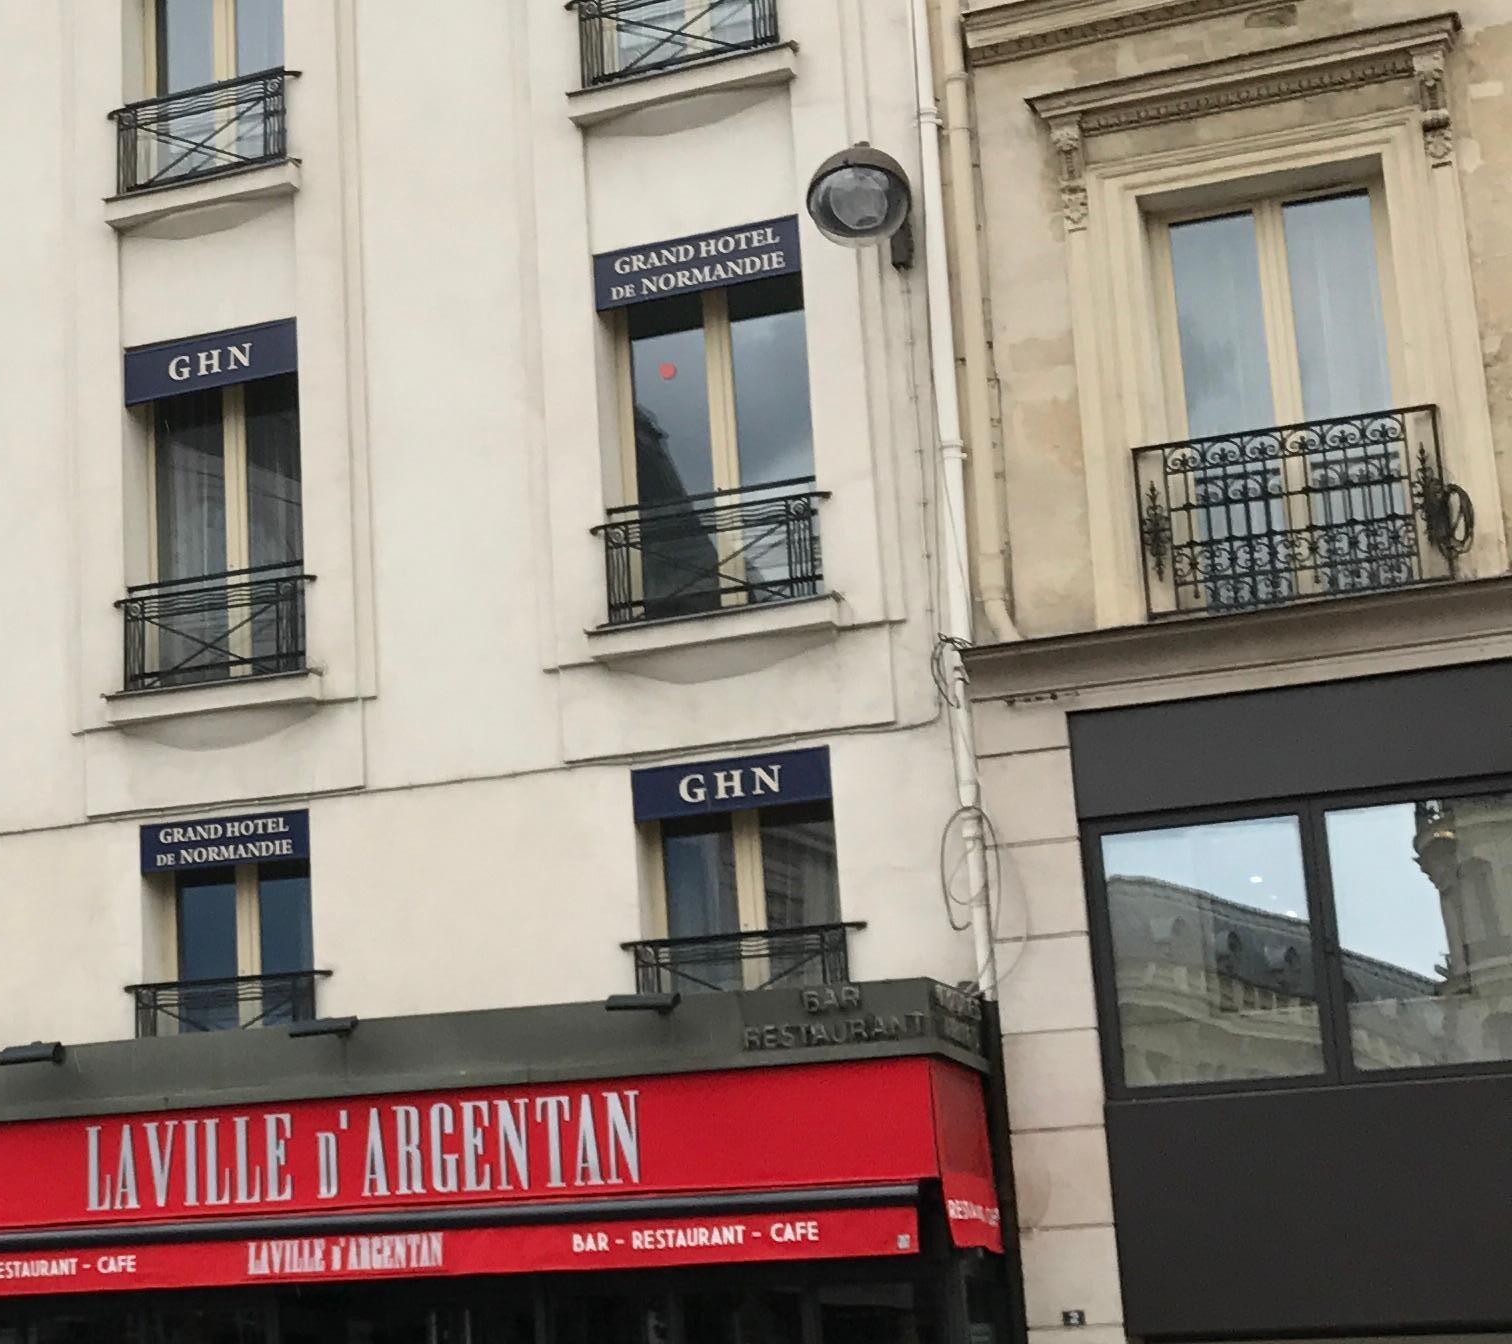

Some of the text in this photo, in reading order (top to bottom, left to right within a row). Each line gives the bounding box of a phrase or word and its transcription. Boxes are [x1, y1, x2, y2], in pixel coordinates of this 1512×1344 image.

[614, 227, 780, 275] GRAND HOTEL
[610, 251, 786, 301] DE NORMANDIE
[168, 342, 253, 381] GHN
[679, 764, 783, 805] GHN
[159, 817, 290, 844] GRAND HOTEL
[156, 839, 294, 867] DE NORMANDIE
[744, 1010, 925, 1049] RESTAURANT
[572, 1232, 610, 1253] BAR
[632, 1225, 746, 1250] RESTAURANT
[770, 1221, 820, 1243] CAFE
[97, 1255, 137, 1274] CAFE
